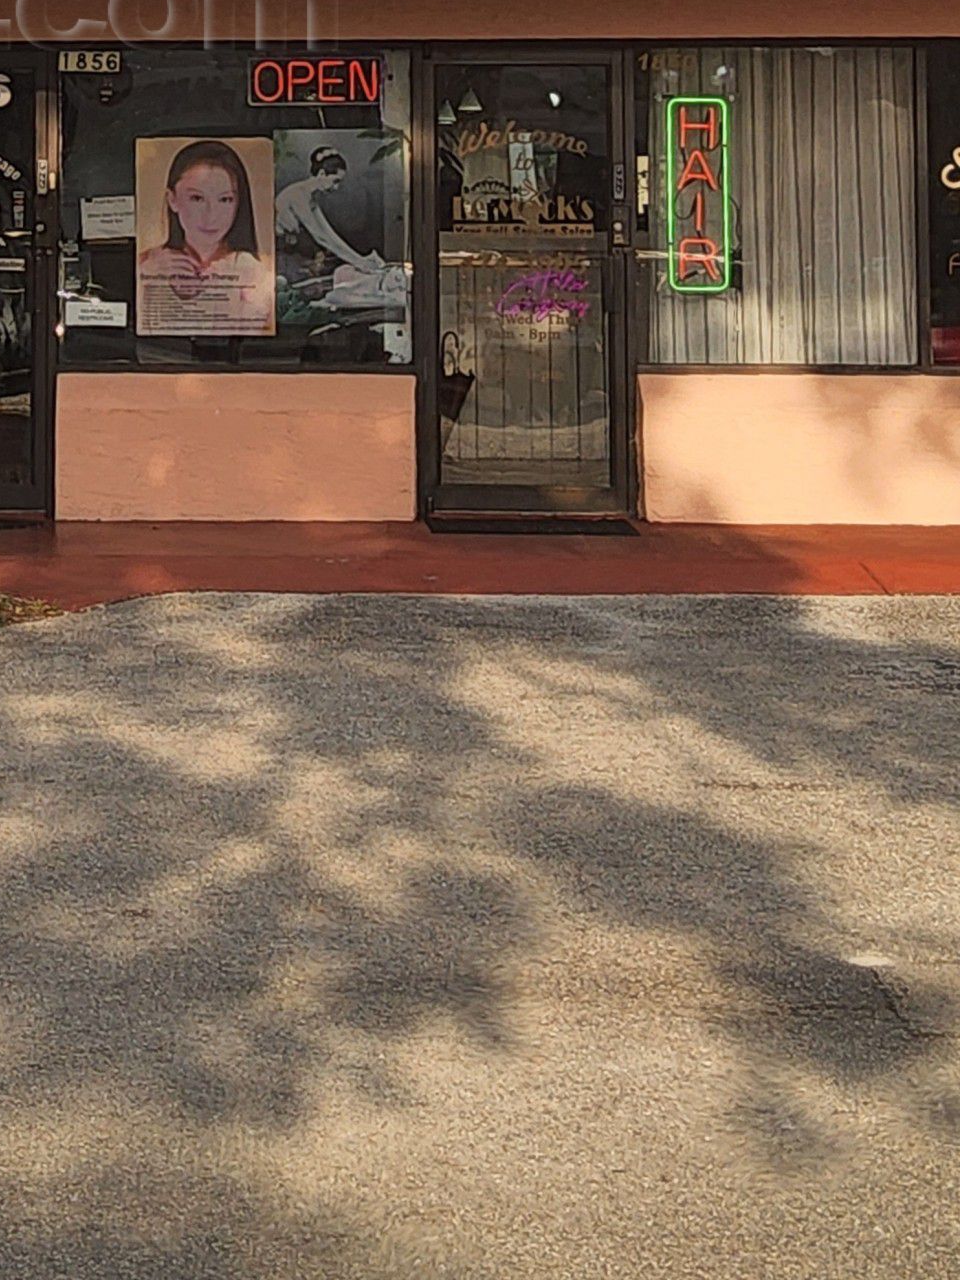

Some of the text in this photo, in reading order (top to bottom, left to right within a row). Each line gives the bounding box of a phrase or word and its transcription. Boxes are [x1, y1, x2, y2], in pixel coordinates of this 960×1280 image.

[62, 52, 119, 71] 1856
[253, 59, 379, 102] OPEN
[457, 120, 588, 158] Welcome
[515, 151, 534, 171] to
[676, 106, 721, 281] HAIR
[528, 329, 561, 342] 8pm
